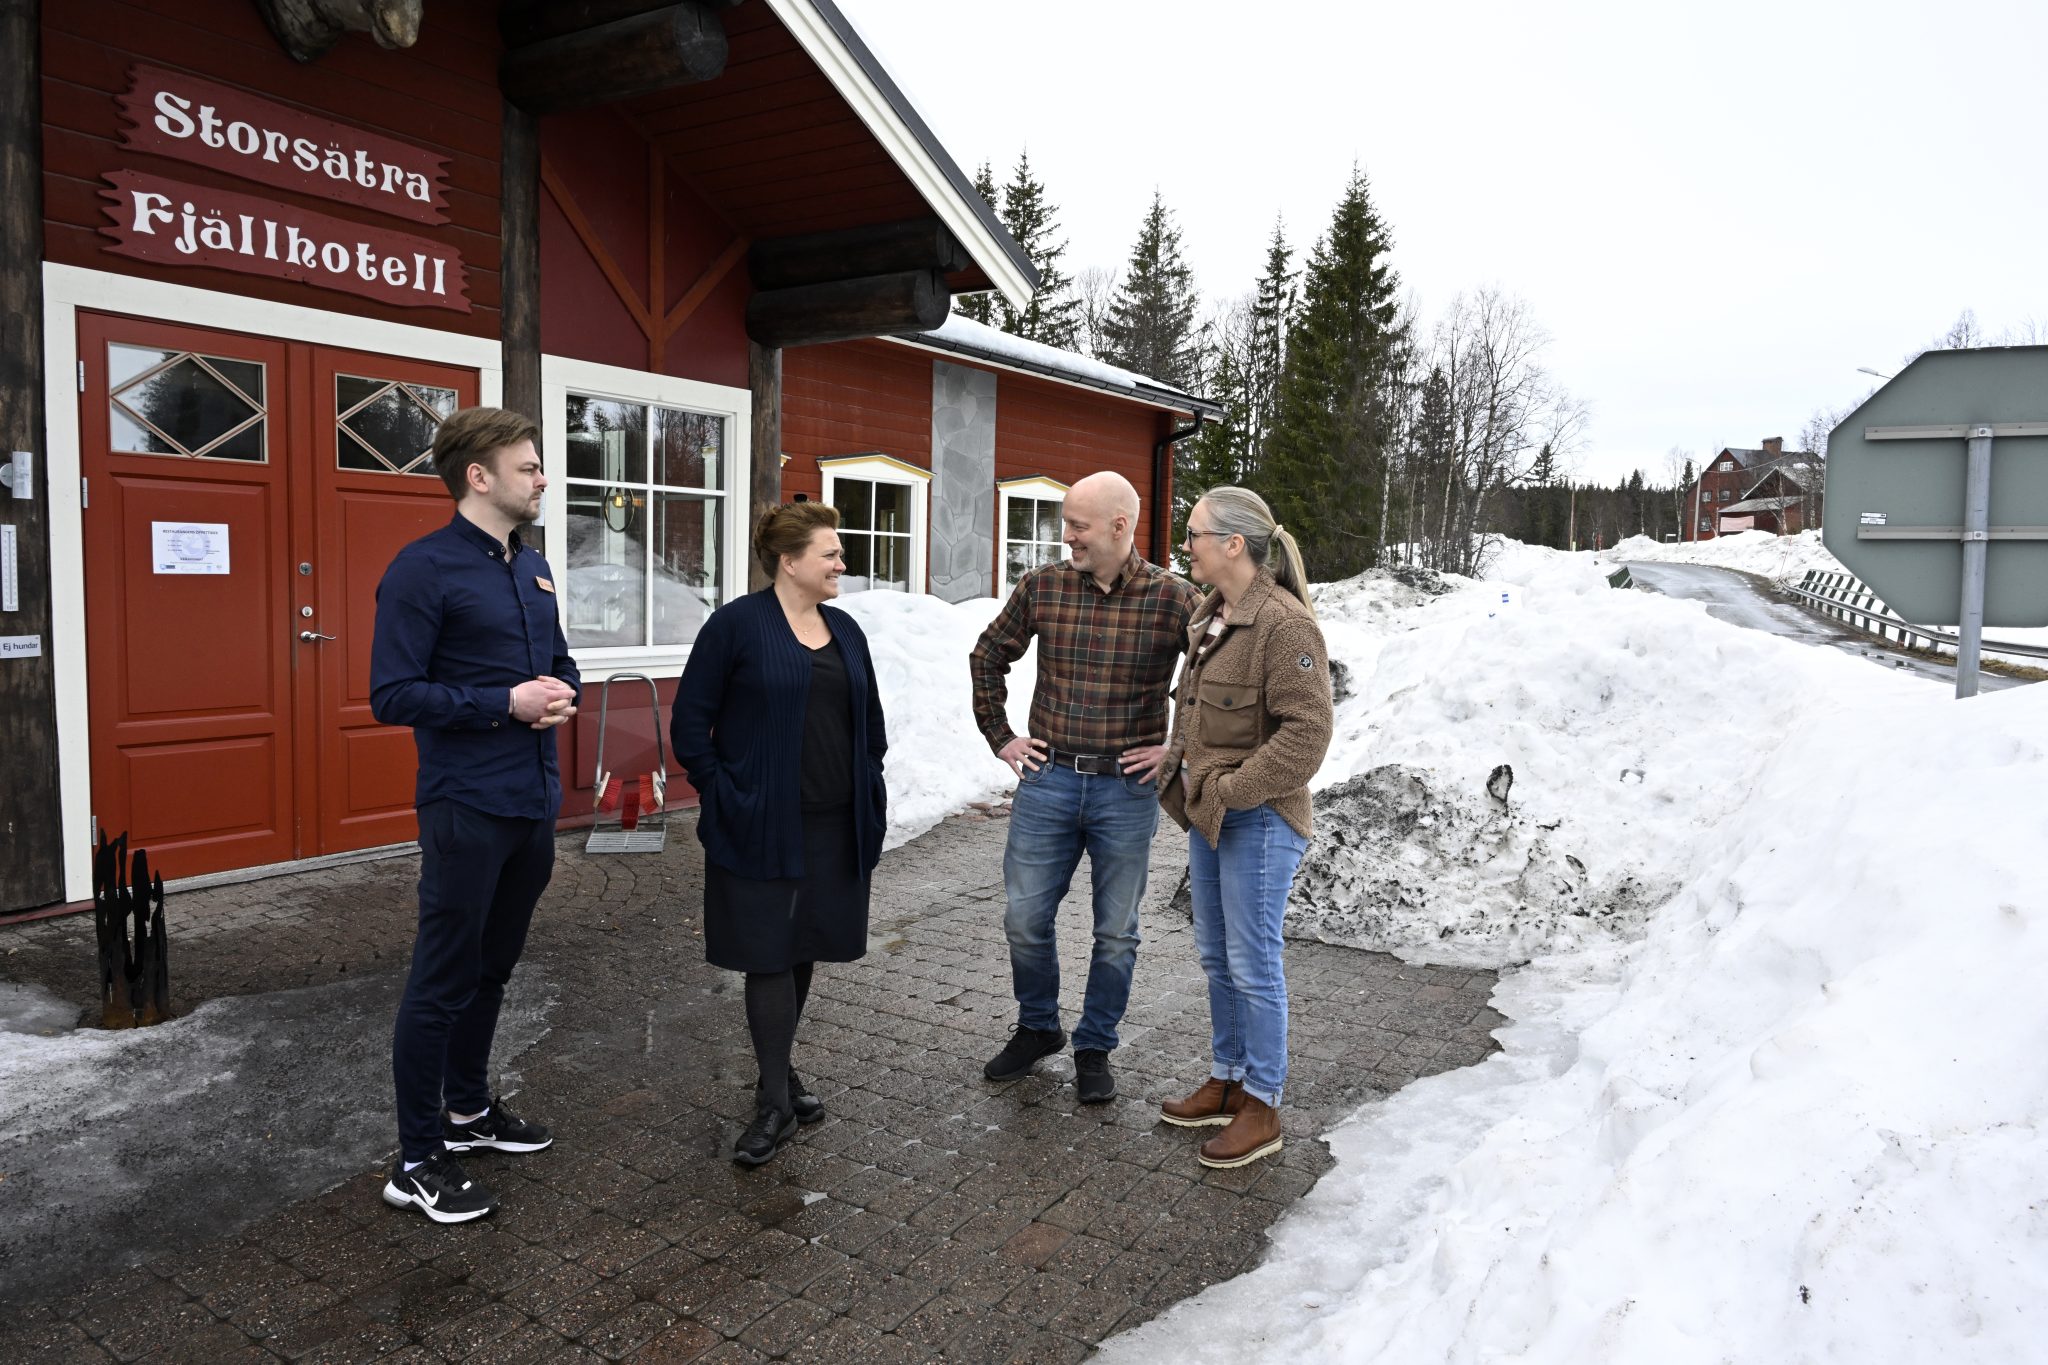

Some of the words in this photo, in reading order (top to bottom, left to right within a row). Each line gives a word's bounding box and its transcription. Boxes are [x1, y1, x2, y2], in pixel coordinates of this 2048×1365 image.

[154, 91, 431, 203] Storsätra
[130, 190, 446, 296] Fjällhotell
[3, 642, 11, 651] Ej
[13, 642, 38, 650] hundar
